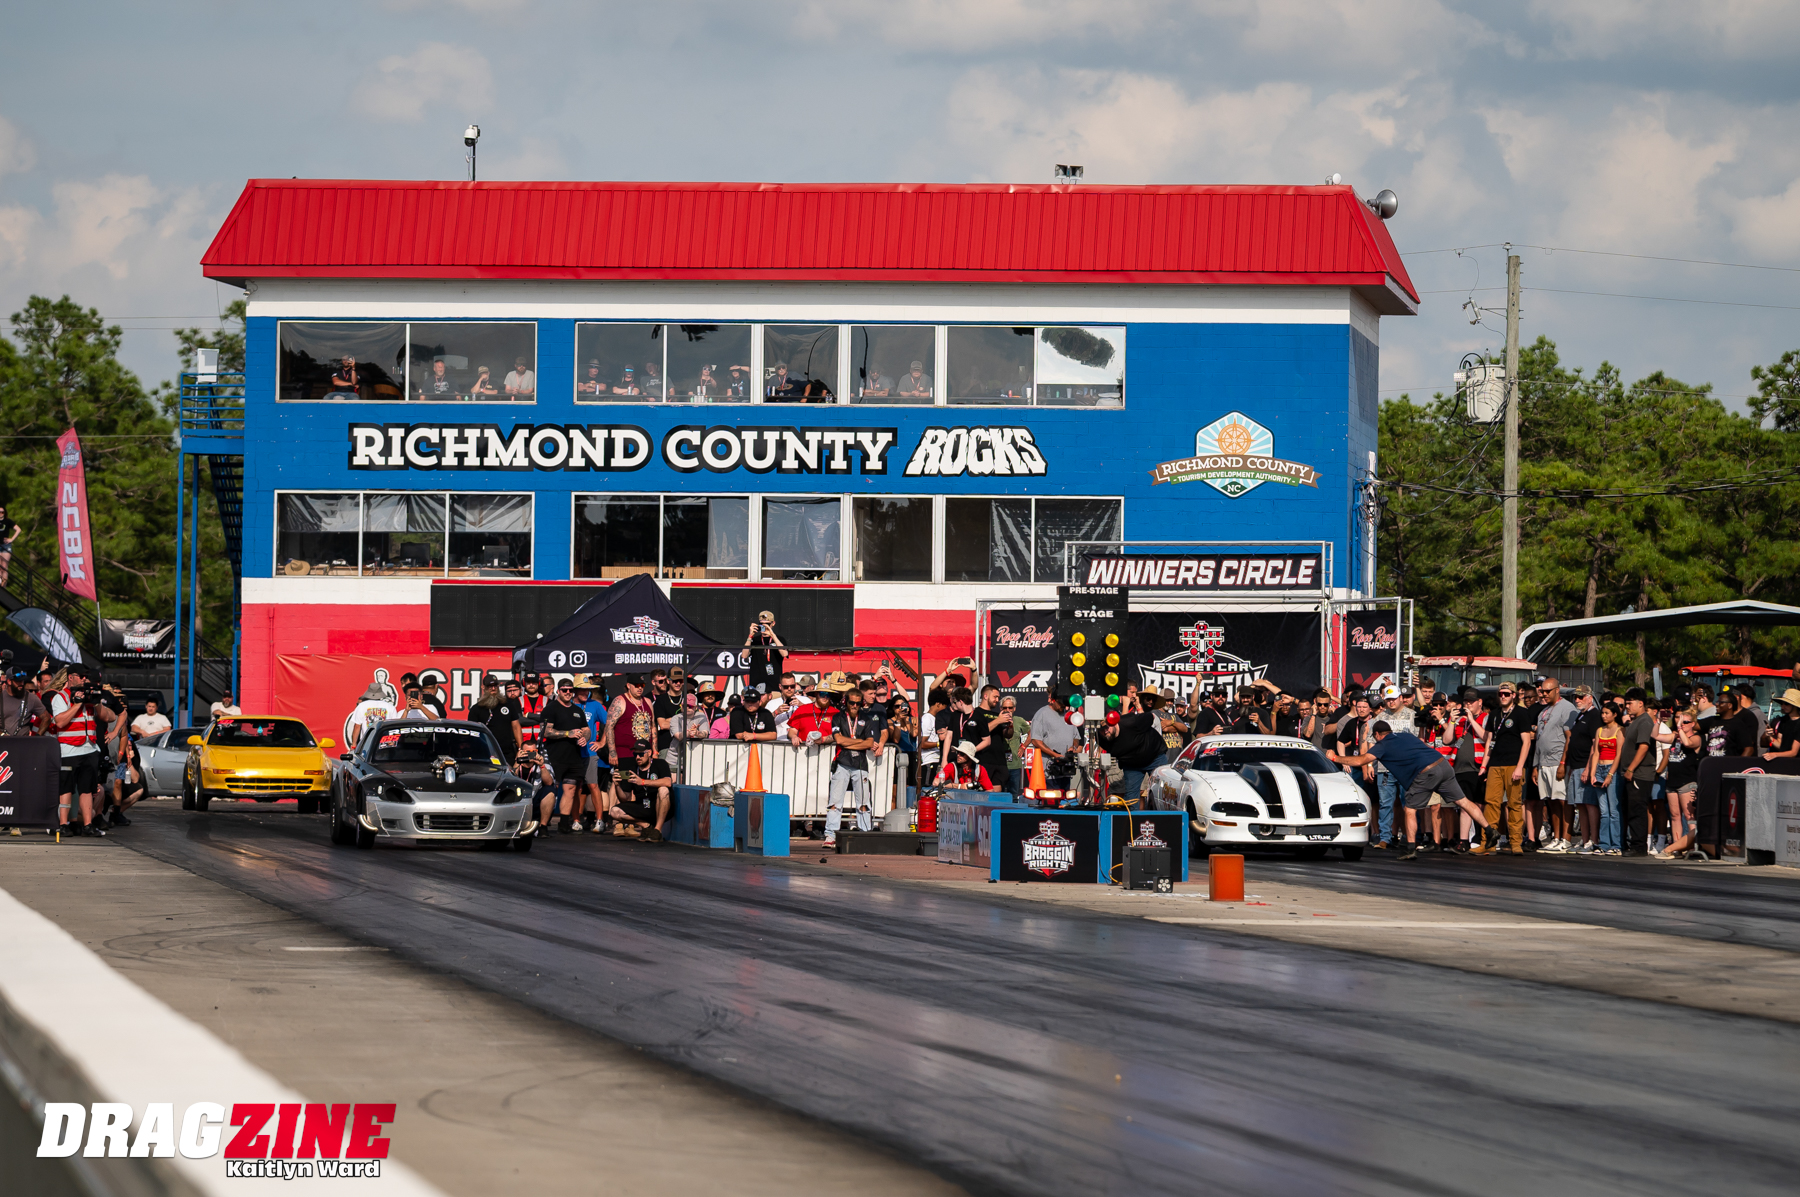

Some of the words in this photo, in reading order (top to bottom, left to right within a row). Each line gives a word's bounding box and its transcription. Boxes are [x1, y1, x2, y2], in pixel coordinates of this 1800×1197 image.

[352, 426, 651, 468] RICHMOND
[666, 428, 893, 472] COUNTY
[904, 427, 1047, 476] ROCKS
[1161, 456, 1243, 476] RICHMOND
[1247, 457, 1309, 477] COUNTY
[1177, 473, 1206, 483] TOURISM
[1207, 471, 1254, 479] DEVELOPMENT
[1255, 473, 1292, 484] AUTHORITY
[1227, 484, 1241, 493] NC
[1087, 559, 1216, 586] WINNERS
[1218, 559, 1317, 585] CIRCLE
[1069, 586, 1119, 595] PRE-STAGE
[1074, 610, 1114, 618] STAGE
[613, 630, 681, 648] BRAGGIN
[1008, 640, 1041, 648] SHADE
[1362, 641, 1390, 650] SHADE
[1155, 662, 1214, 672] STREET
[1217, 662, 1249, 672] CAR
[388, 726, 481, 738] RENEGADE
[1024, 845, 1074, 862] BRAGGIN
[1029, 859, 1068, 869] RIGHTS
